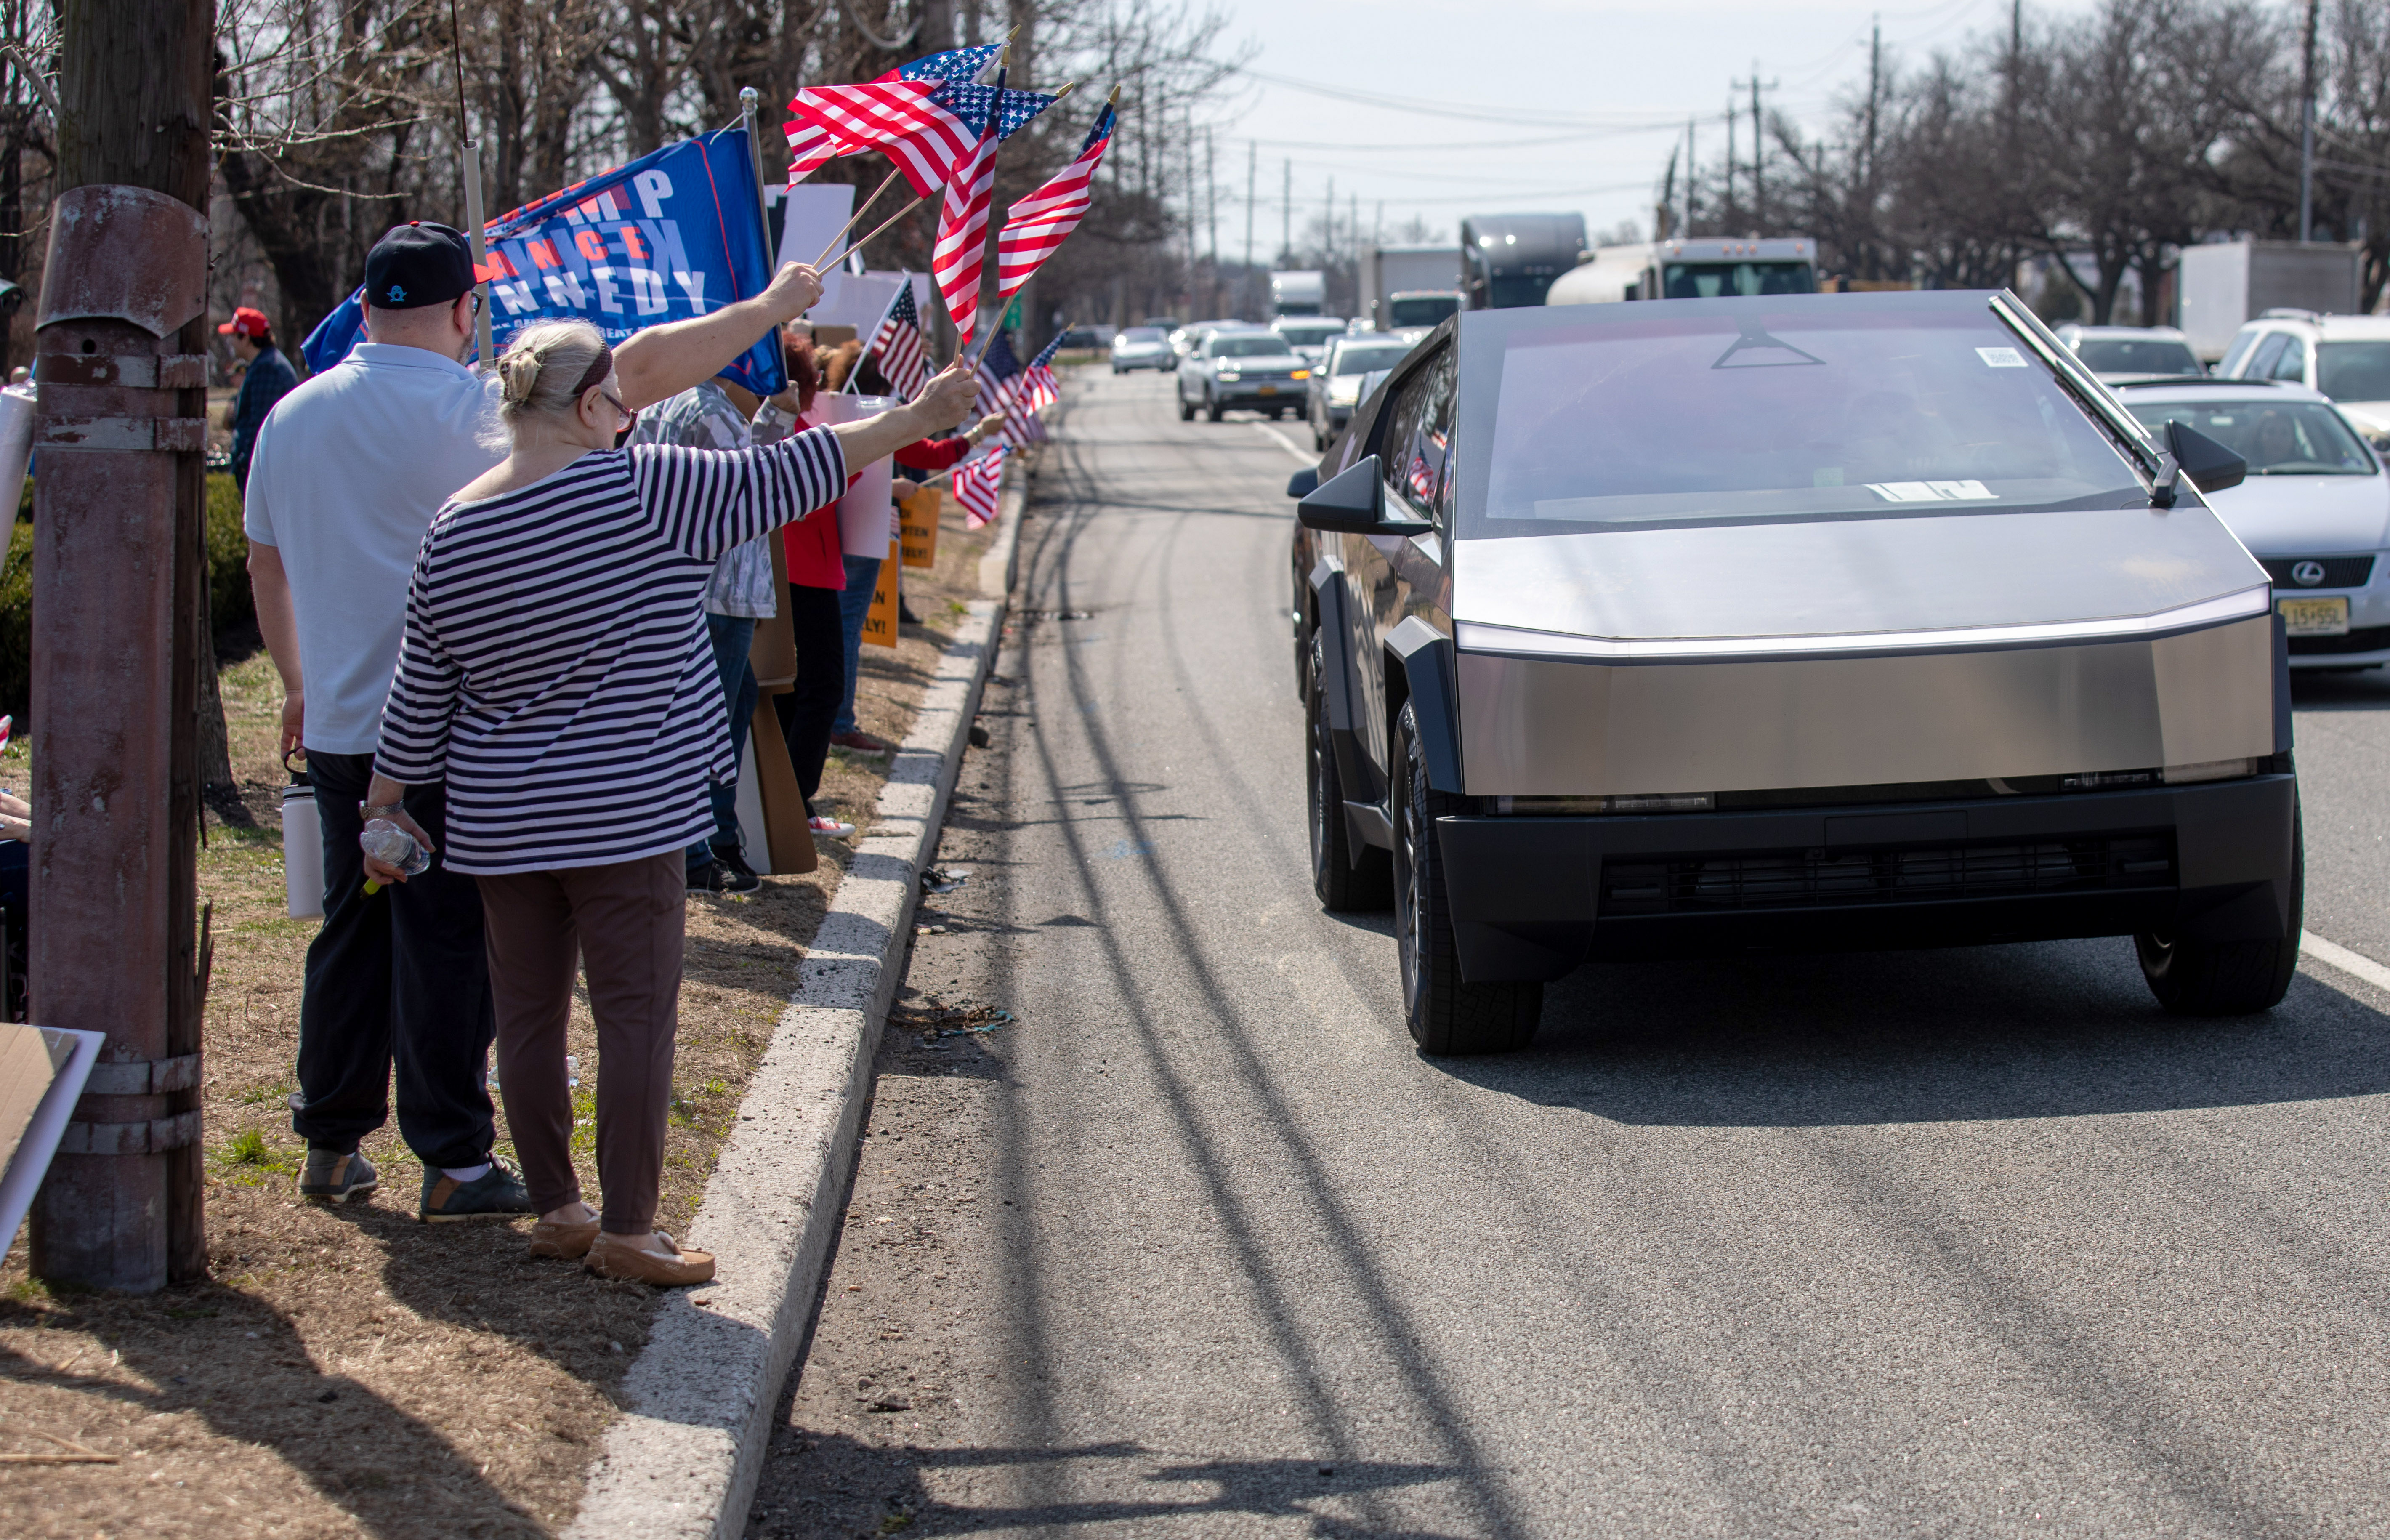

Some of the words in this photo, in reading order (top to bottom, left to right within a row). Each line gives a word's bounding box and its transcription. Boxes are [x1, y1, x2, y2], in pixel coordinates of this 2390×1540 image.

[486, 226, 649, 281] ANCE
[490, 266, 707, 319] NNEDY
[862, 617, 886, 635] LY!
